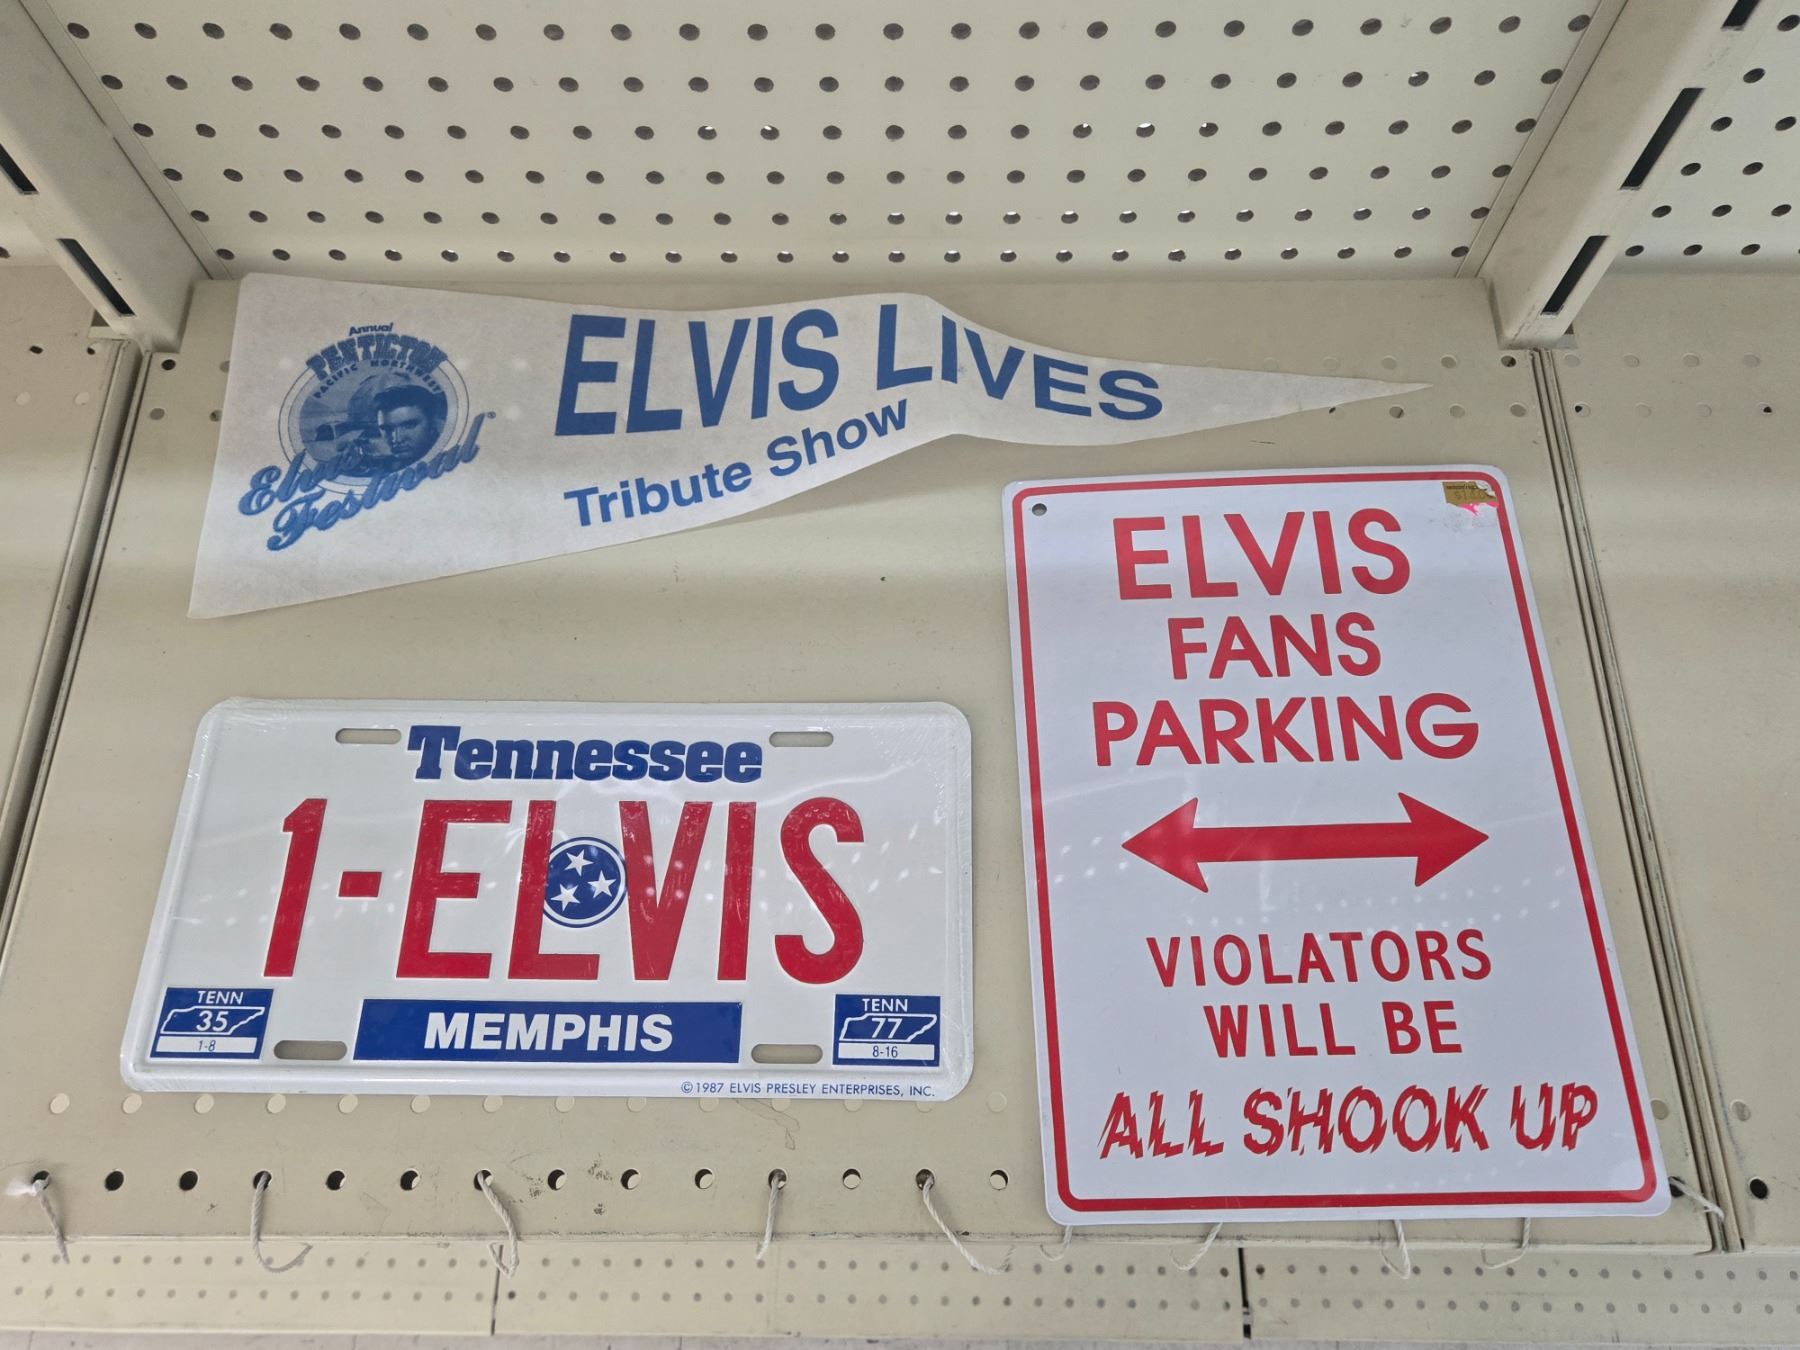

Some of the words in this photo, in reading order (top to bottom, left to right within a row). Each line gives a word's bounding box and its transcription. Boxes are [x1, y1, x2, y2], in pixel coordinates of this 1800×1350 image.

[349, 322, 393, 336] Annual
[313, 363, 359, 399] PACIFIC
[370, 359, 442, 393] NORTHWEST
[555, 309, 839, 436] ELVIS
[877, 303, 1163, 421] LIVES
[564, 462, 752, 527] Tribute
[766, 398, 908, 478] Show
[1113, 508, 1410, 599] ELVIS
[1167, 611, 1381, 680] FANS
[1092, 692, 1479, 766] PARKING
[407, 725, 763, 783] Tennessee
[1146, 928, 1492, 988] VIOLATORS
[197, 990, 243, 1005] TENN
[862, 998, 908, 1013] TENN
[196, 1010, 229, 1032] 35
[424, 1012, 673, 1052] MEMPHIS
[870, 1017, 902, 1040] 77
[1203, 1003, 1356, 1058] WILL
[1382, 1000, 1463, 1054] BE
[198, 1040, 216, 1052] 1-8
[872, 1045, 899, 1059] 8-16
[729, 1082, 761, 1094] ELVIS
[766, 1083, 816, 1095] PRESLEY
[822, 1084, 904, 1096] ENTERPRISES,
[909, 1086, 936, 1097] INC.
[1099, 1090, 1224, 1159] ALL
[1243, 1084, 1489, 1156] SHOOK
[1511, 1082, 1598, 1151] UP
